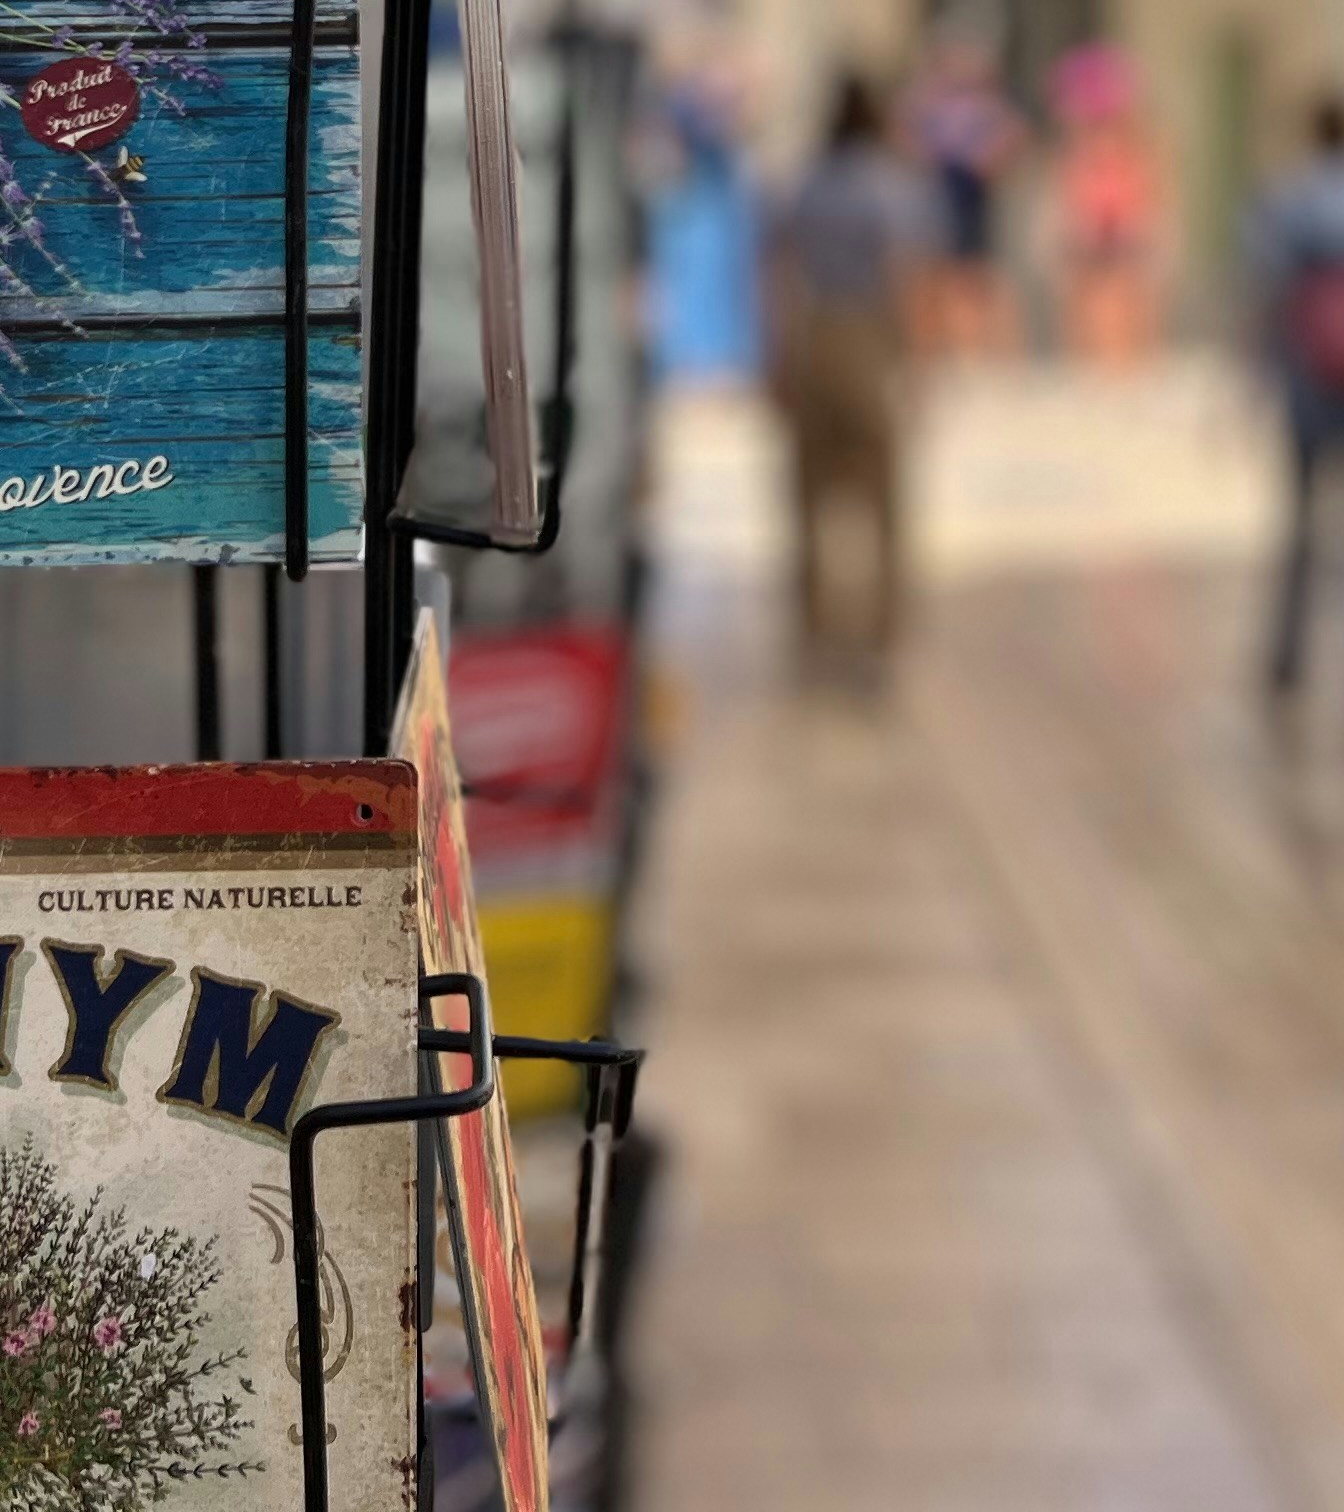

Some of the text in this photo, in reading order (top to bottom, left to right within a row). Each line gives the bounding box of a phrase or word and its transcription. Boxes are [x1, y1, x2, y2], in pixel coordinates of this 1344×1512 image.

[27, 65, 113, 105] Produit
[64, 93, 87, 112] de
[43, 103, 127, 136] France
[38, 886, 362, 912] CULTURE NATURELLE
